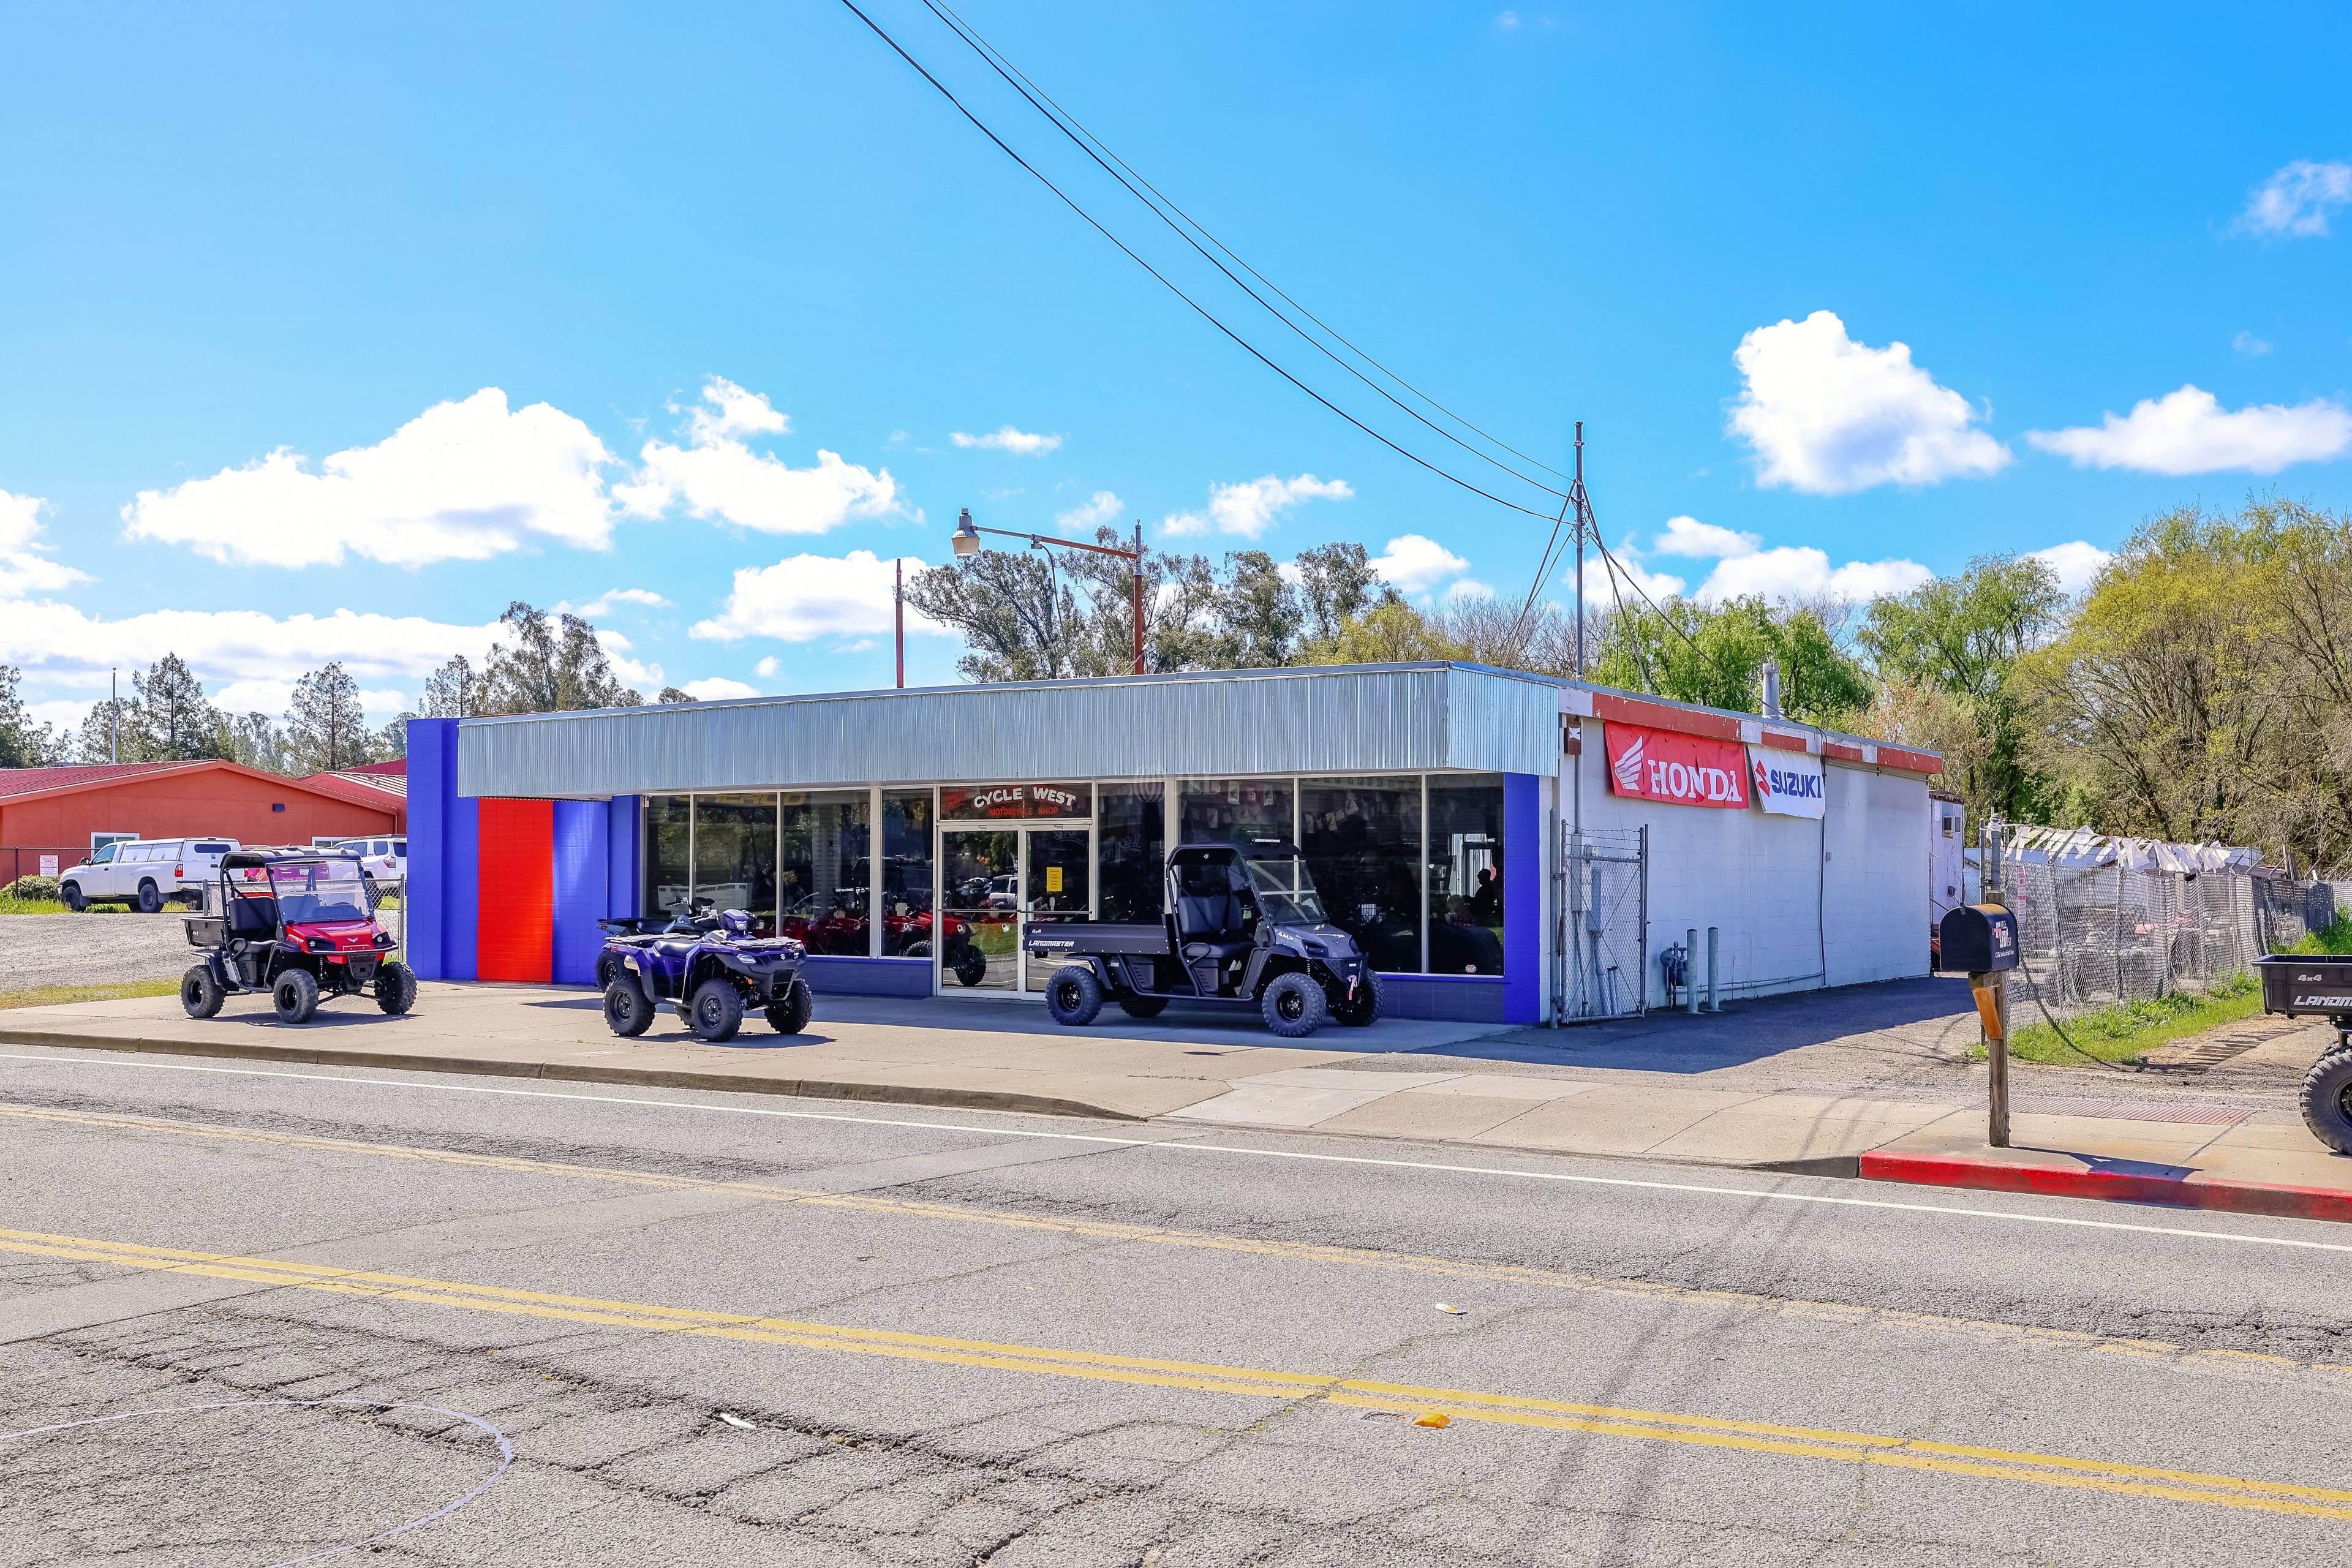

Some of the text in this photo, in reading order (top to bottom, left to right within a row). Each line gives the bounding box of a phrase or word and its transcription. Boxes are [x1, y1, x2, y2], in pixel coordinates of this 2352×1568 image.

[1648, 759, 1743, 802] HONDA
[1770, 769, 1823, 799] SUZUKI
[974, 788, 1023, 809] CYCLE
[1033, 786, 1077, 807] WEST
[989, 807, 1033, 816] MOTORCYCLE
